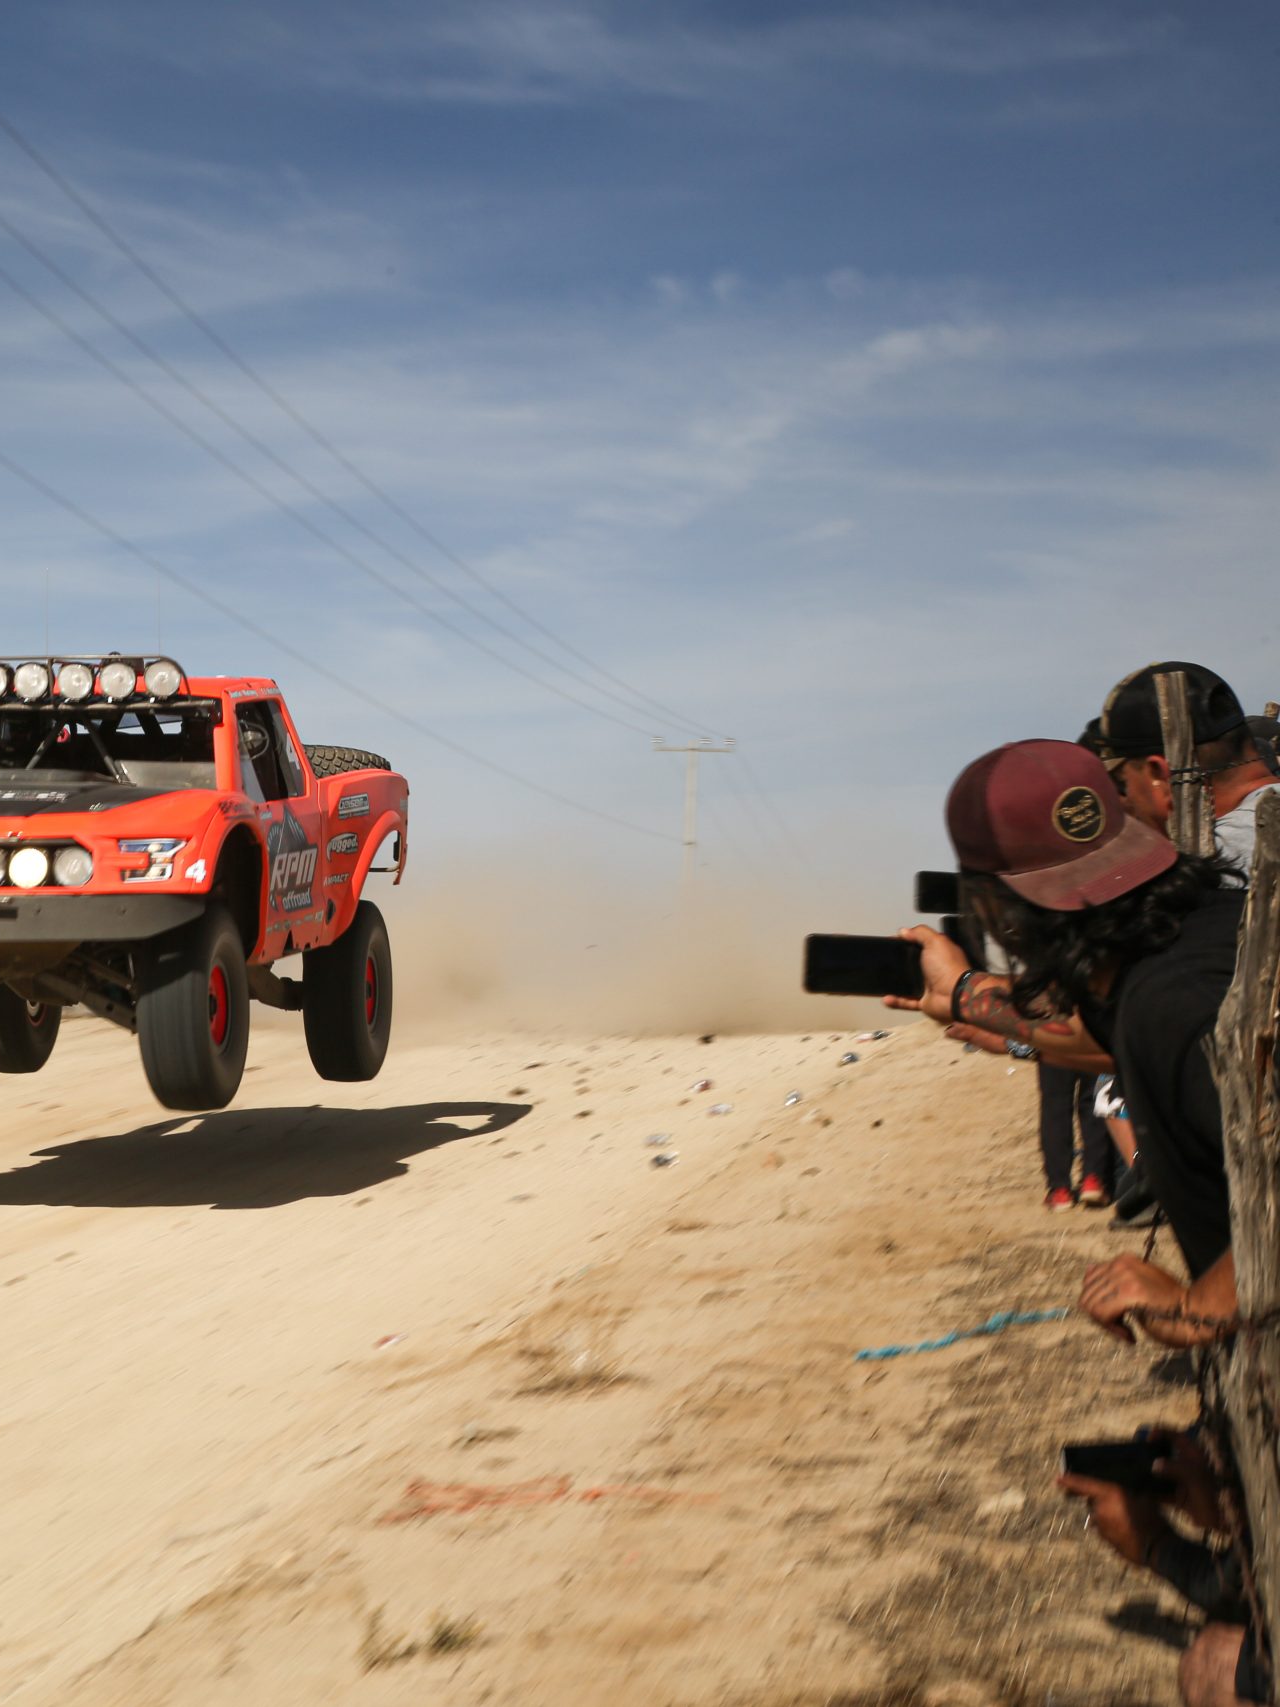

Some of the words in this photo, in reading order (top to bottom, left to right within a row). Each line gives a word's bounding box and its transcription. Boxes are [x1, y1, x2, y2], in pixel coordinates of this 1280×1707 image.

[184, 859, 207, 883] 4
[270, 847, 318, 892] RPM
[282, 888, 311, 909] offroad
